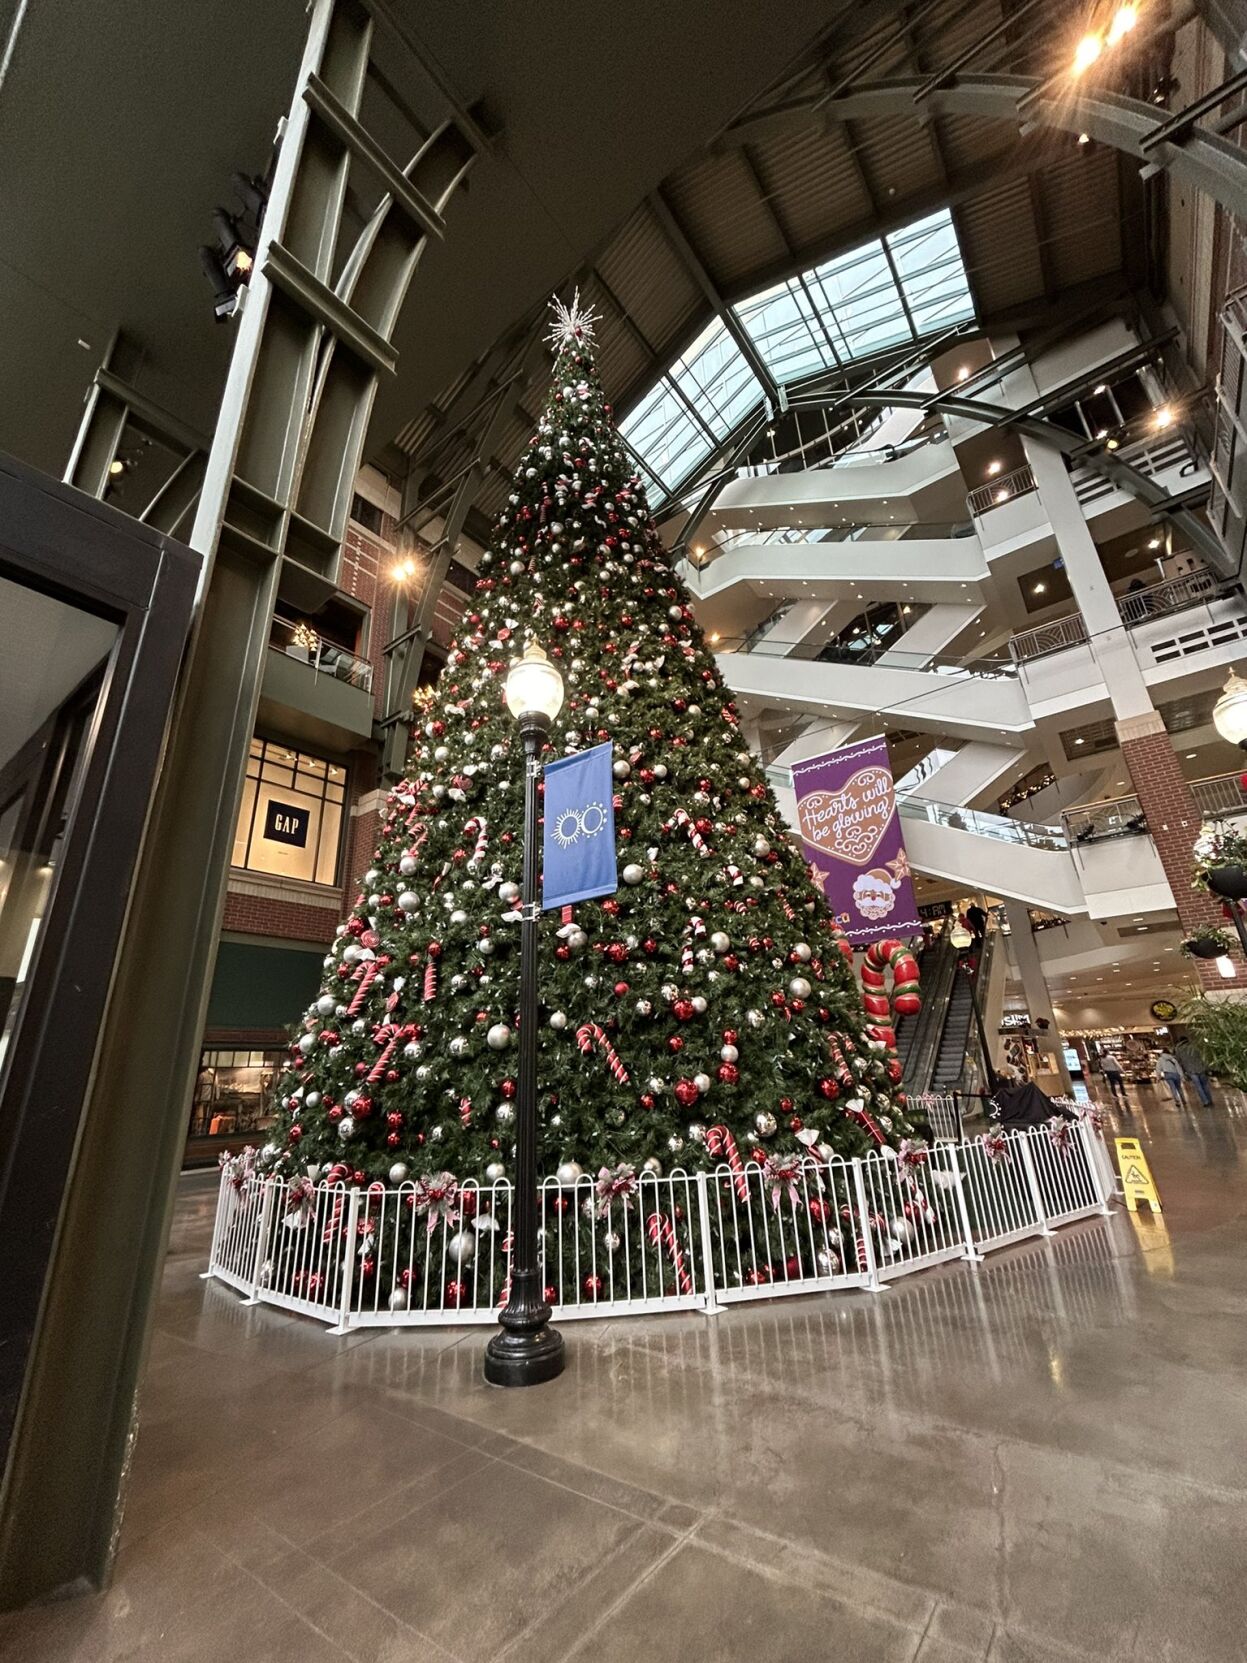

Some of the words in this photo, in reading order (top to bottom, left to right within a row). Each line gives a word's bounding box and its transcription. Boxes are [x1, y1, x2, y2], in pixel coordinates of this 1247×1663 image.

[274, 813, 299, 835] GAP
[802, 792, 860, 830] Hearts
[862, 776, 892, 802] will
[812, 826, 831, 842] be
[832, 796, 889, 839] glowing
